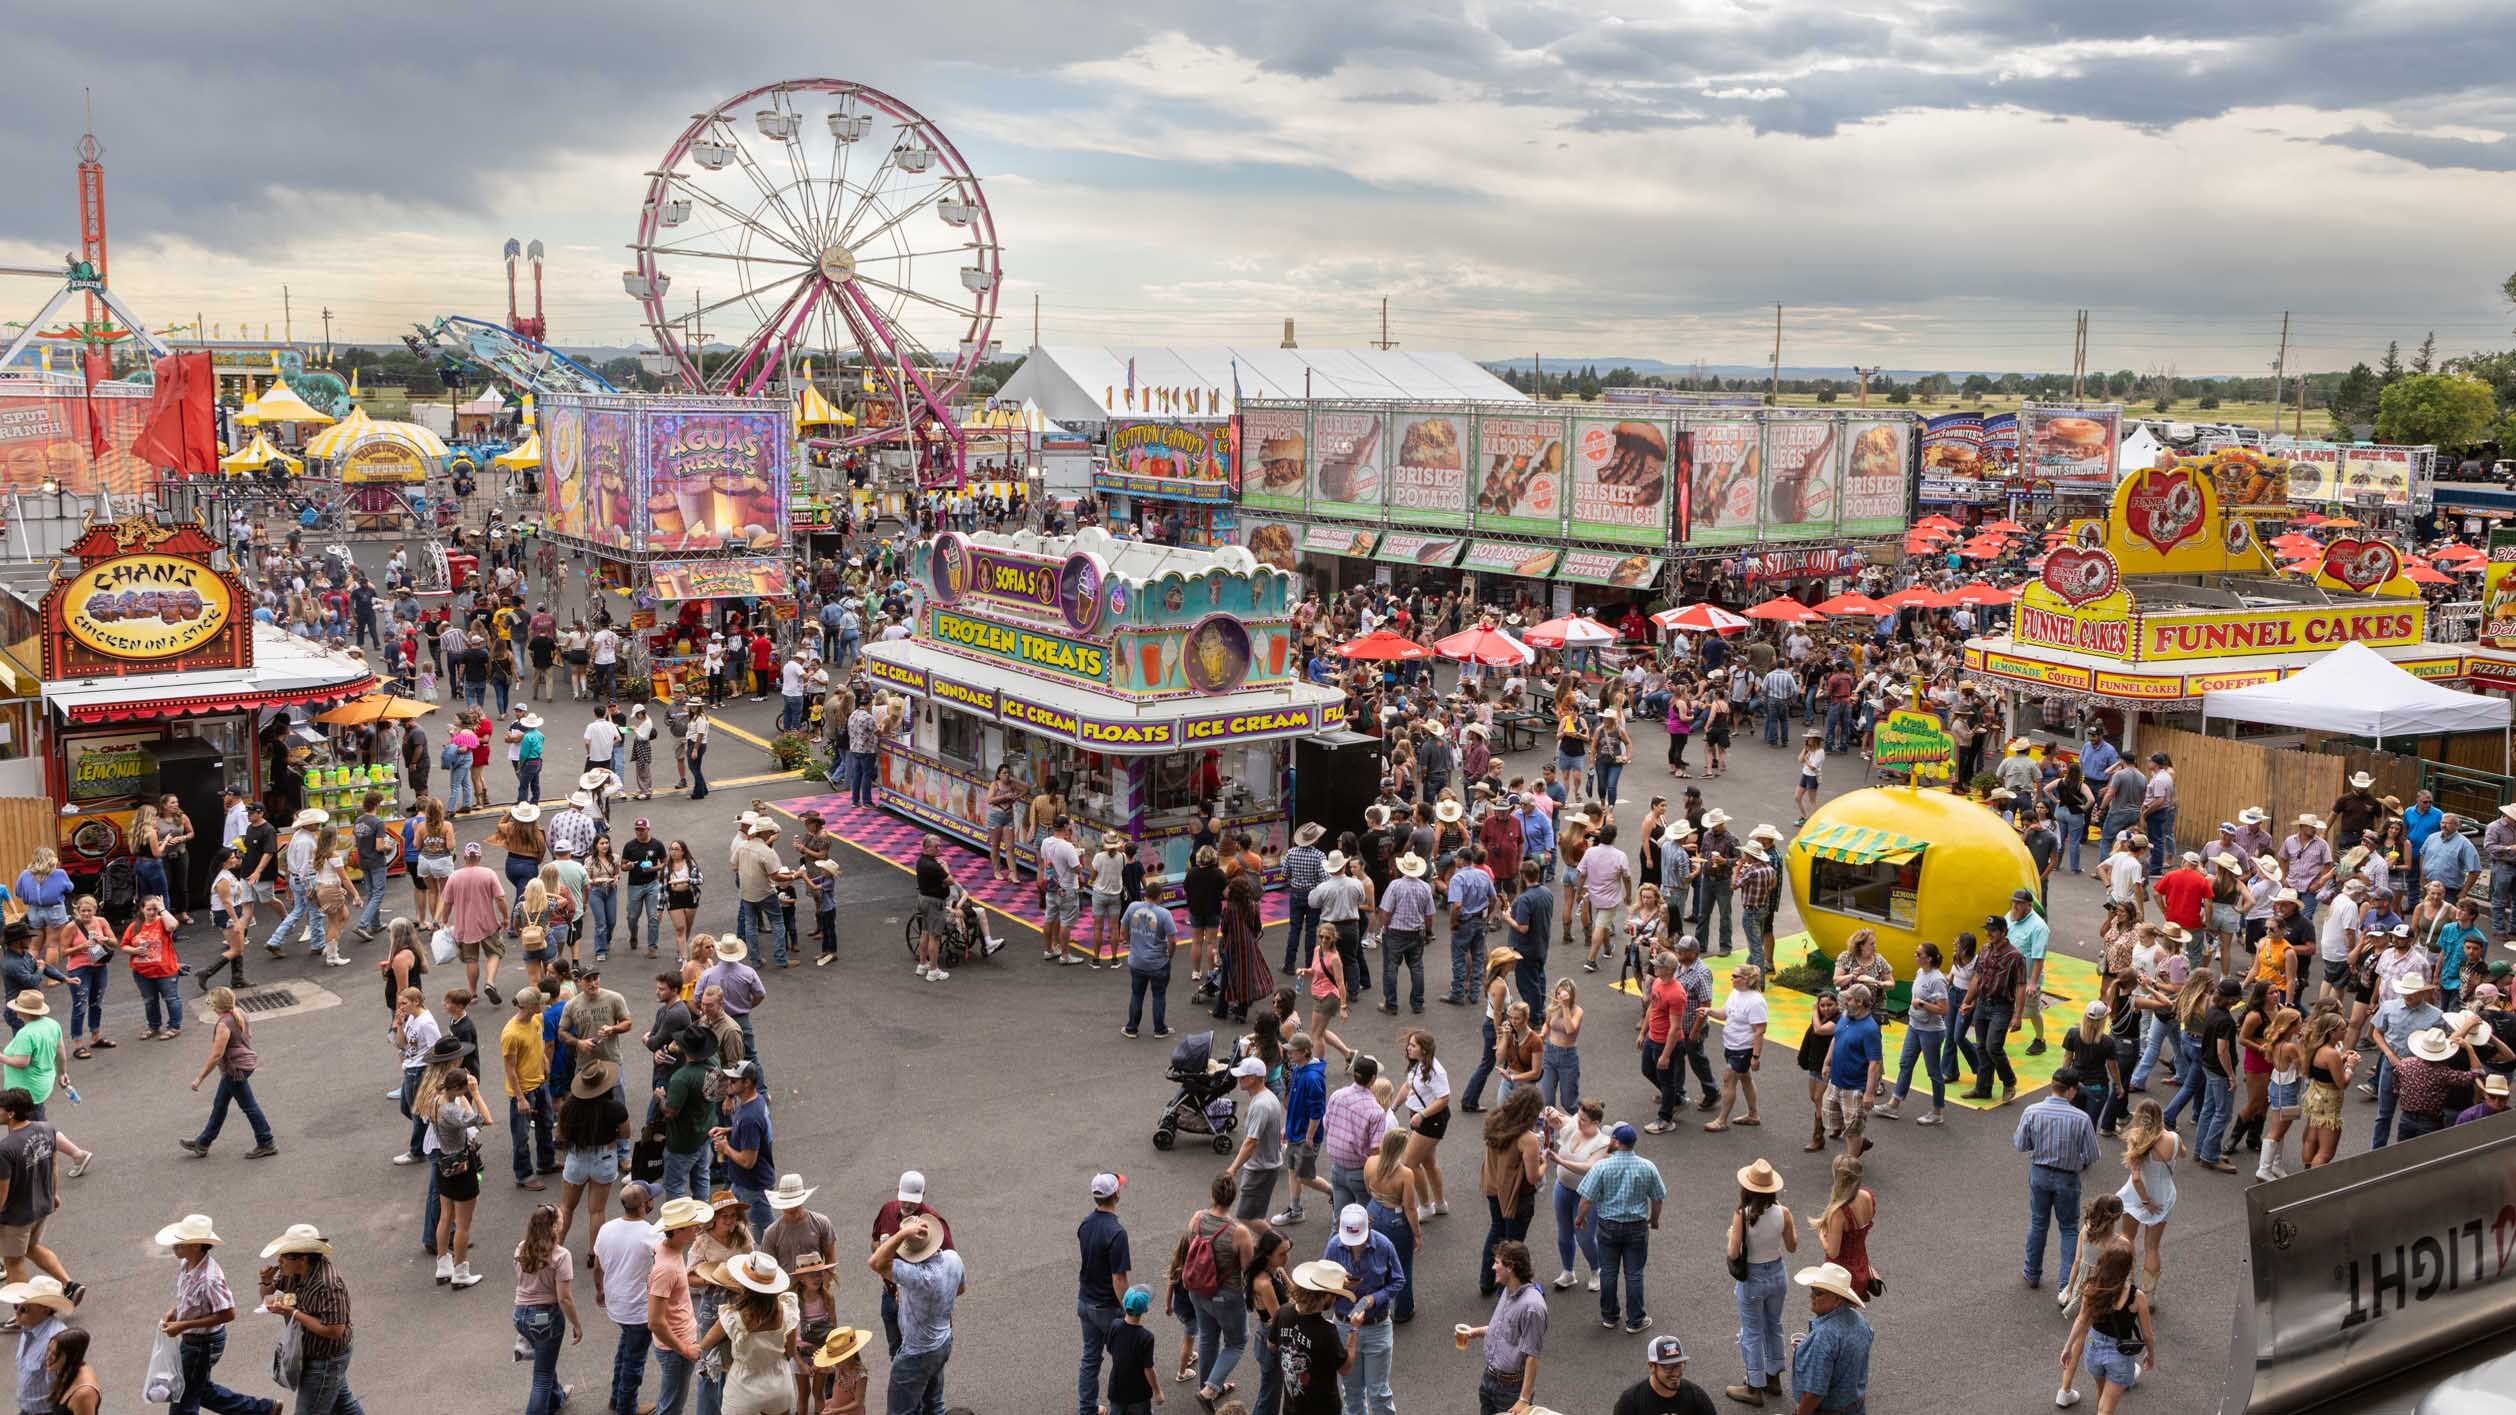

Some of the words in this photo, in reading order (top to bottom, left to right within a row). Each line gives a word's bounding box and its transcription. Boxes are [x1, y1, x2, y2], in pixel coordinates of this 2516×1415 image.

[1243, 427, 1292, 441] SANDWICH
[1316, 415, 1369, 434] TURKEY
[1481, 419, 1525, 435] CHICKEN
[668, 430, 760, 458] AGUAS
[1113, 423, 1160, 452] COTTON
[1161, 425, 1206, 457] CANDY
[1771, 425, 1824, 446] TURKEY
[1481, 437, 1537, 456] KABOBS
[669, 454, 757, 479] FRESCAS
[1771, 447, 1806, 470] LEGS
[1393, 465, 1465, 488] BRISKET
[2035, 464, 2063, 477] DONUT
[2063, 462, 2108, 476] SANDWICH
[1574, 482, 1637, 502] BRISKET
[1844, 475, 1903, 495] BRISKET
[1393, 487, 1465, 510] POTATO
[1844, 496, 1902, 517] POTATO
[2131, 496, 2168, 509] FUNNEL
[1573, 503, 1657, 526] SANDWICH
[1470, 543, 1498, 559] HOT
[1499, 546, 1531, 562] DOGS
[1567, 552, 1617, 567] BRISKET
[1810, 549, 1839, 572] OUT
[94, 563, 197, 591] CHAN'S
[1562, 563, 1610, 578] POTATO
[2051, 566, 2082, 577] FUNNEL
[73, 616, 141, 650] CHICKEN
[144, 637, 166, 650] ON
[169, 636, 179, 647] A
[182, 608, 222, 644] STICK
[2020, 606, 2077, 646] FUNNEL
[2078, 619, 2128, 655] CAKES
[2153, 619, 2297, 654] FUNNEL
[2304, 613, 2414, 645] CAKES
[938, 615, 1015, 653] FROZEN
[1020, 634, 1103, 677] TREATS
[871, 660, 887, 677] ICE
[888, 666, 924, 689] CREAM
[1989, 660, 2042, 678] LEMONADE
[2047, 671, 2086, 687] COFFEE
[2413, 662, 2457, 677] PICKLES
[2471, 662, 2505, 676] PIZZA
[934, 679, 994, 709] SUNDAES
[2099, 681, 2142, 693] FUNNEL
[2144, 683, 2177, 694] CAKES
[2201, 677, 2267, 692] COFFEE
[1003, 698, 1024, 718] ICE
[1026, 705, 1076, 735] CREAM
[1187, 720, 1225, 739] ICE
[1229, 711, 1309, 734] CREAM
[1900, 715, 1929, 730] Fresh
[1082, 721, 1171, 744] FLOATS
[1890, 721, 1939, 739] Squeezed
[1877, 733, 1951, 765] Lemonade
